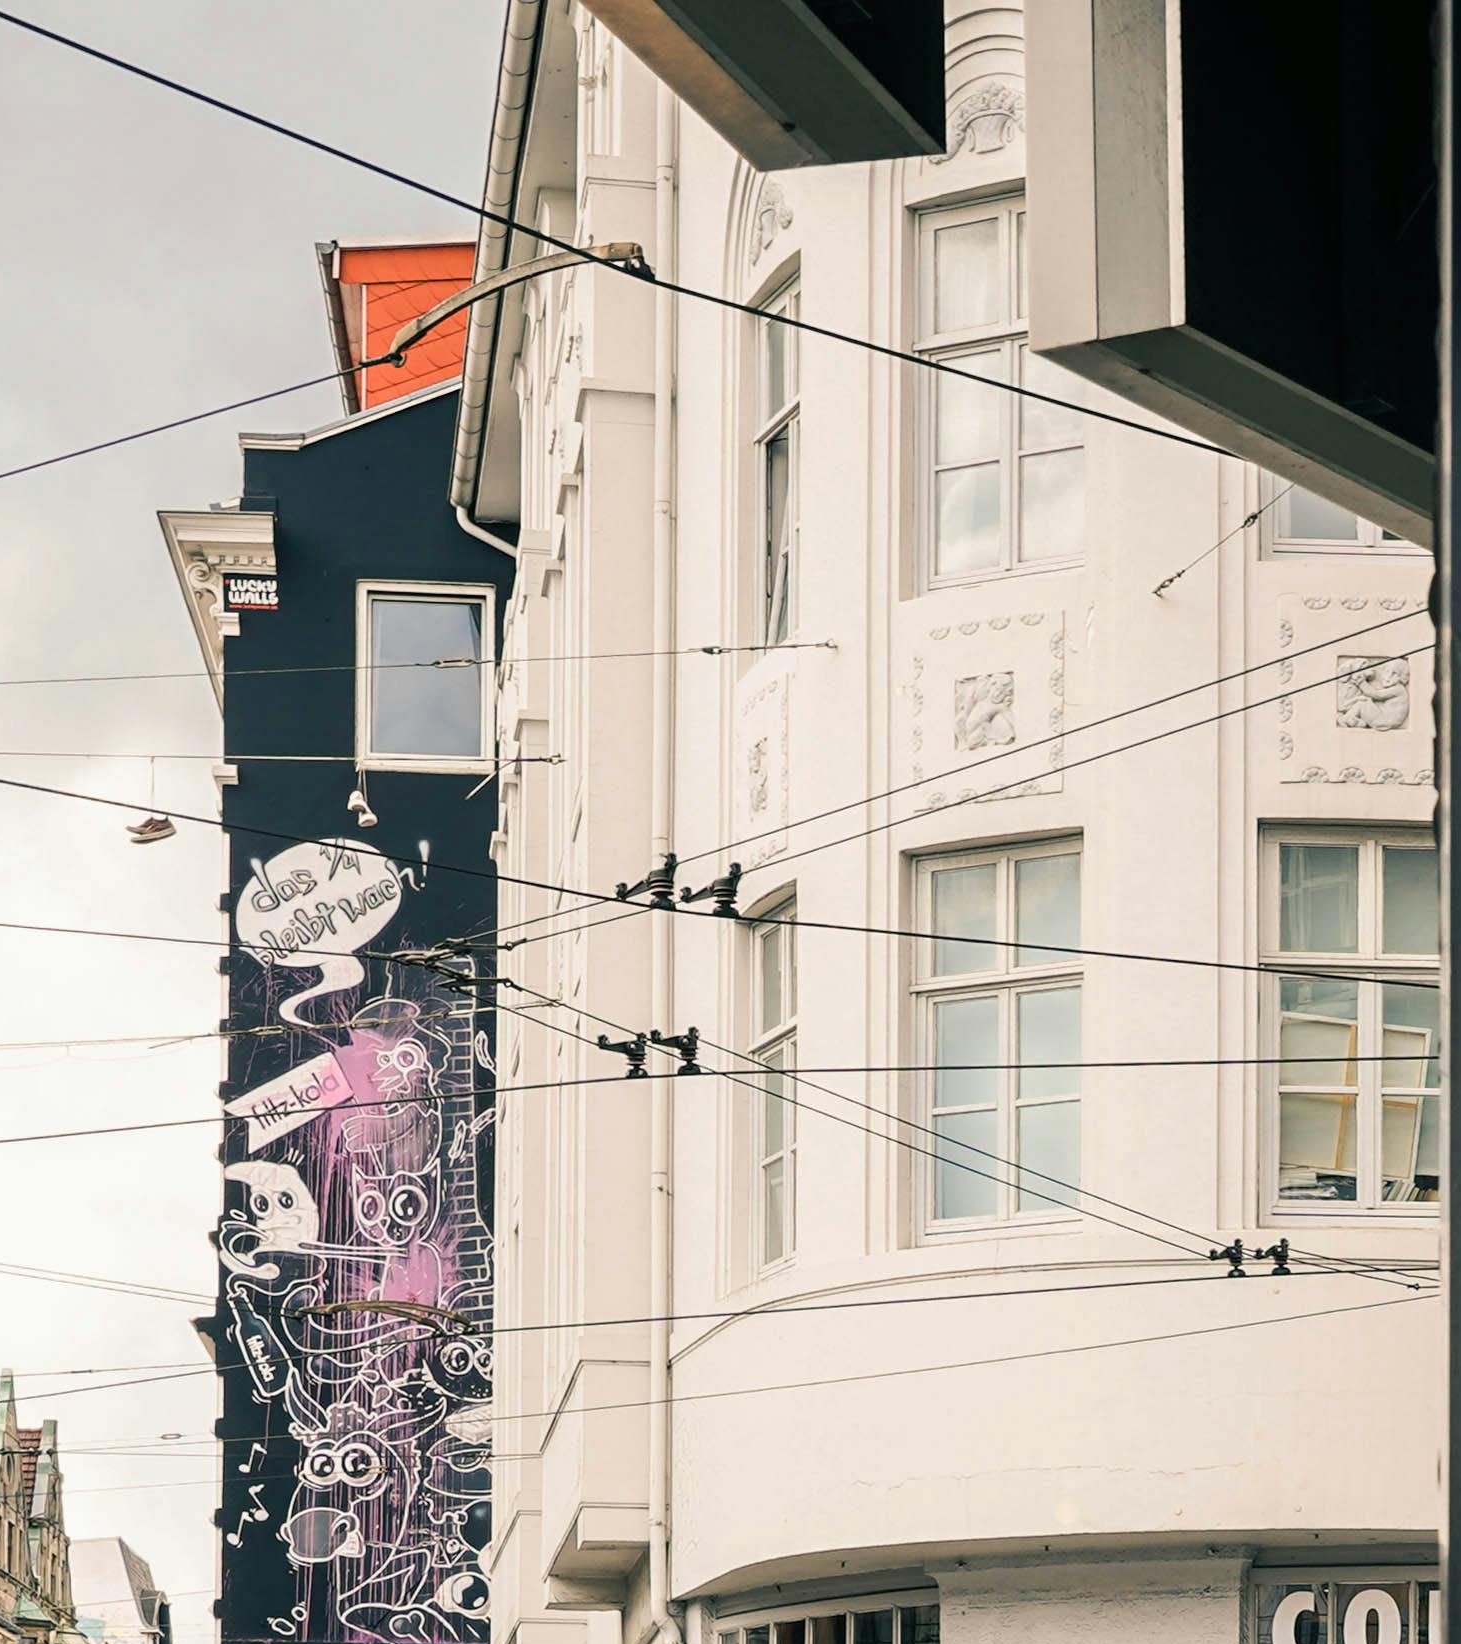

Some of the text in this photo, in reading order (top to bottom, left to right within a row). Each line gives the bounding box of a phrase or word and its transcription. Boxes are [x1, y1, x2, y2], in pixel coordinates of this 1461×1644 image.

[250, 857, 318, 914] das
[241, 896, 339, 969] bleibt
[250, 1070, 340, 1131] fritz-kola
